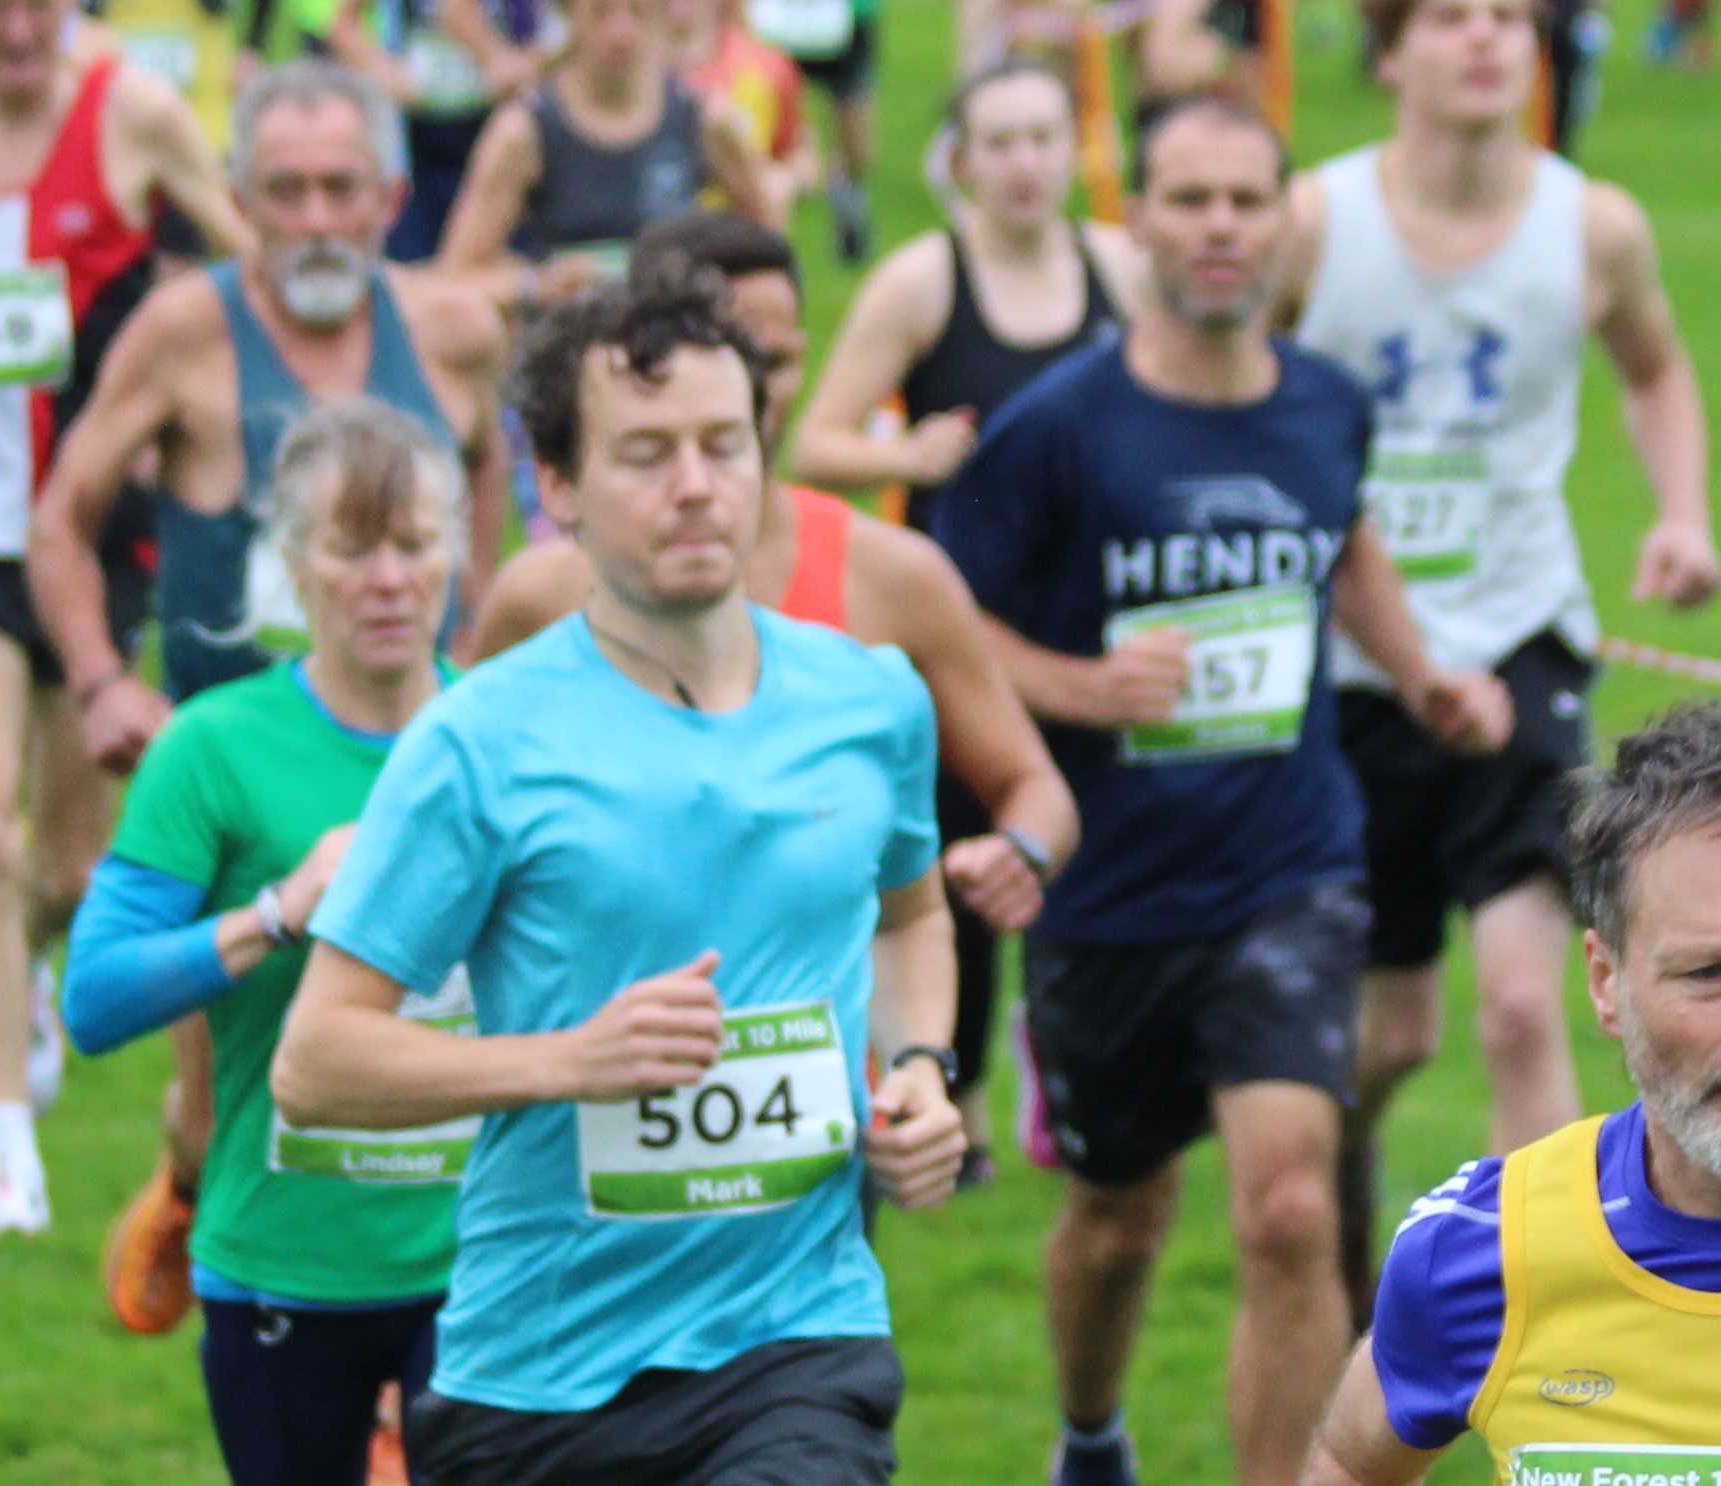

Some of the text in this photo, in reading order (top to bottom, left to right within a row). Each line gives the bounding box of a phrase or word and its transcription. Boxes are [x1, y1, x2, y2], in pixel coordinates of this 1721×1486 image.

[1104, 528, 1344, 598] HENDY
[1187, 643, 1269, 703] 57
[747, 1024, 776, 1047] 10
[782, 1017, 827, 1043] Mile
[637, 1073, 803, 1151] 504
[342, 1149, 446, 1175] Lindsay
[686, 1172, 763, 1204] Mark
[1546, 1379, 1612, 1403] wasp
